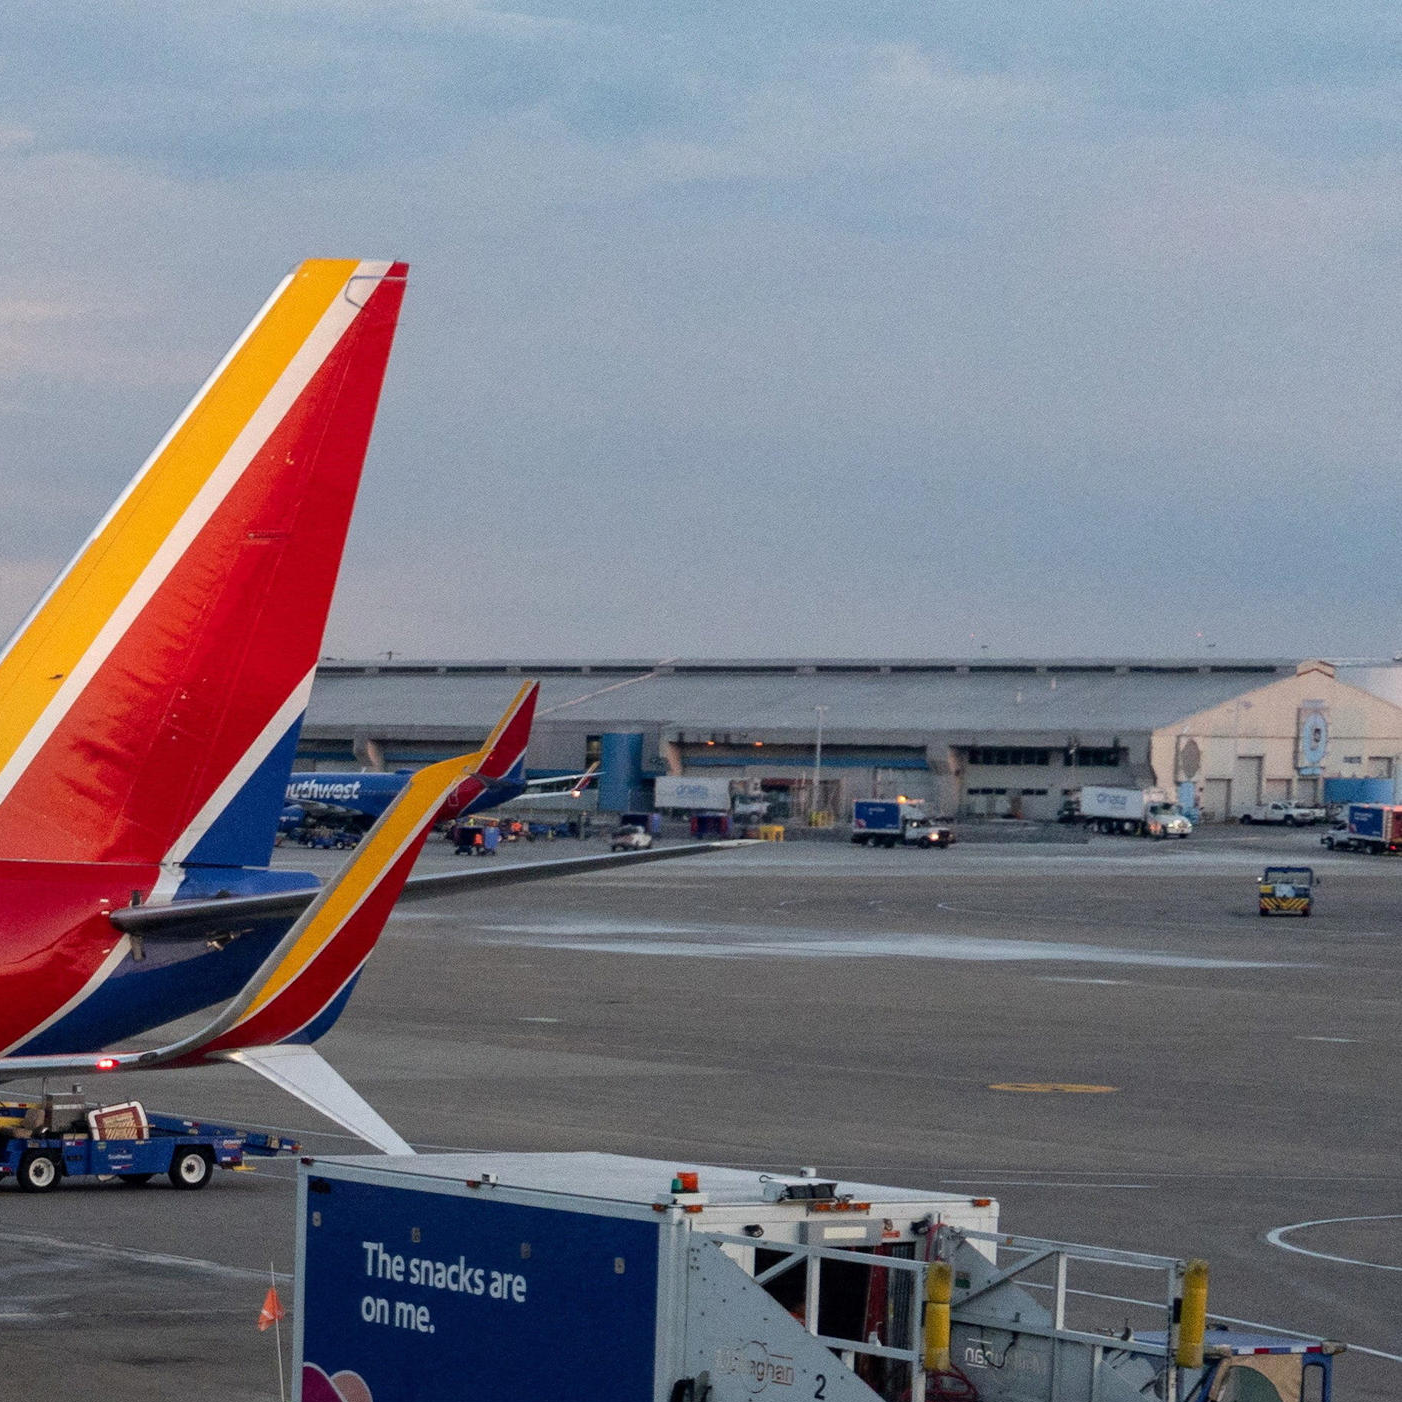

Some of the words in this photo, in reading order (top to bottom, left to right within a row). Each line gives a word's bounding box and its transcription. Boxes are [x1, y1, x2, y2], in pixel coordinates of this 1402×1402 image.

[362, 1241, 406, 1282] The
[409, 1255, 486, 1296] snacks
[489, 1270, 528, 1303] are
[361, 1295, 390, 1325] on
[395, 1300, 436, 1334] me.
[814, 1373, 827, 1400] 2
